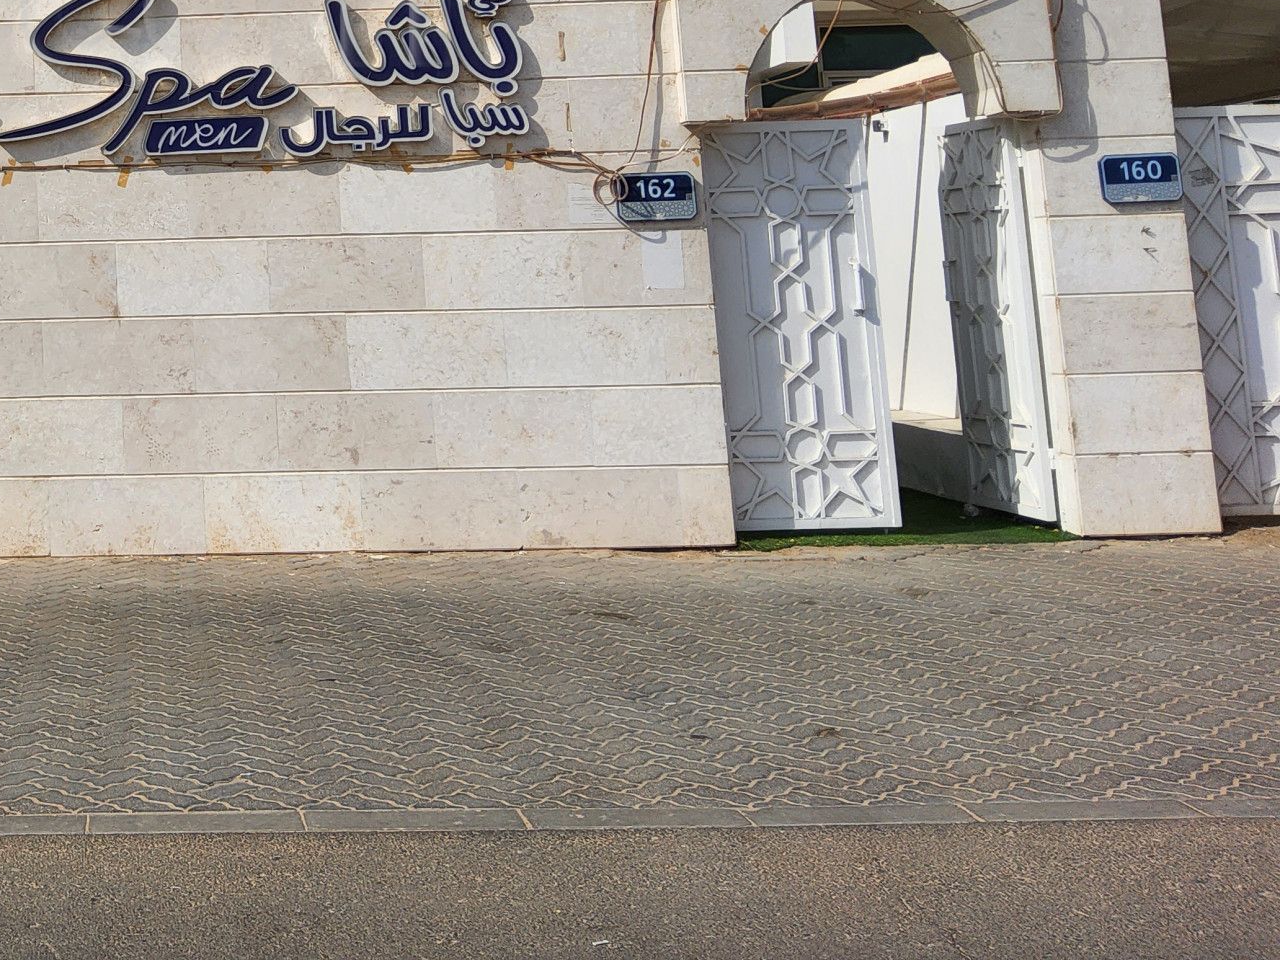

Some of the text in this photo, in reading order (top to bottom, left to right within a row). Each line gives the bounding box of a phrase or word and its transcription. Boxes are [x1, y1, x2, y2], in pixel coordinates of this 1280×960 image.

[278, 86, 530, 157] سبا للرجال
[158, 122, 253, 150] men
[1119, 159, 1162, 180] 160
[636, 178, 676, 198] 162
